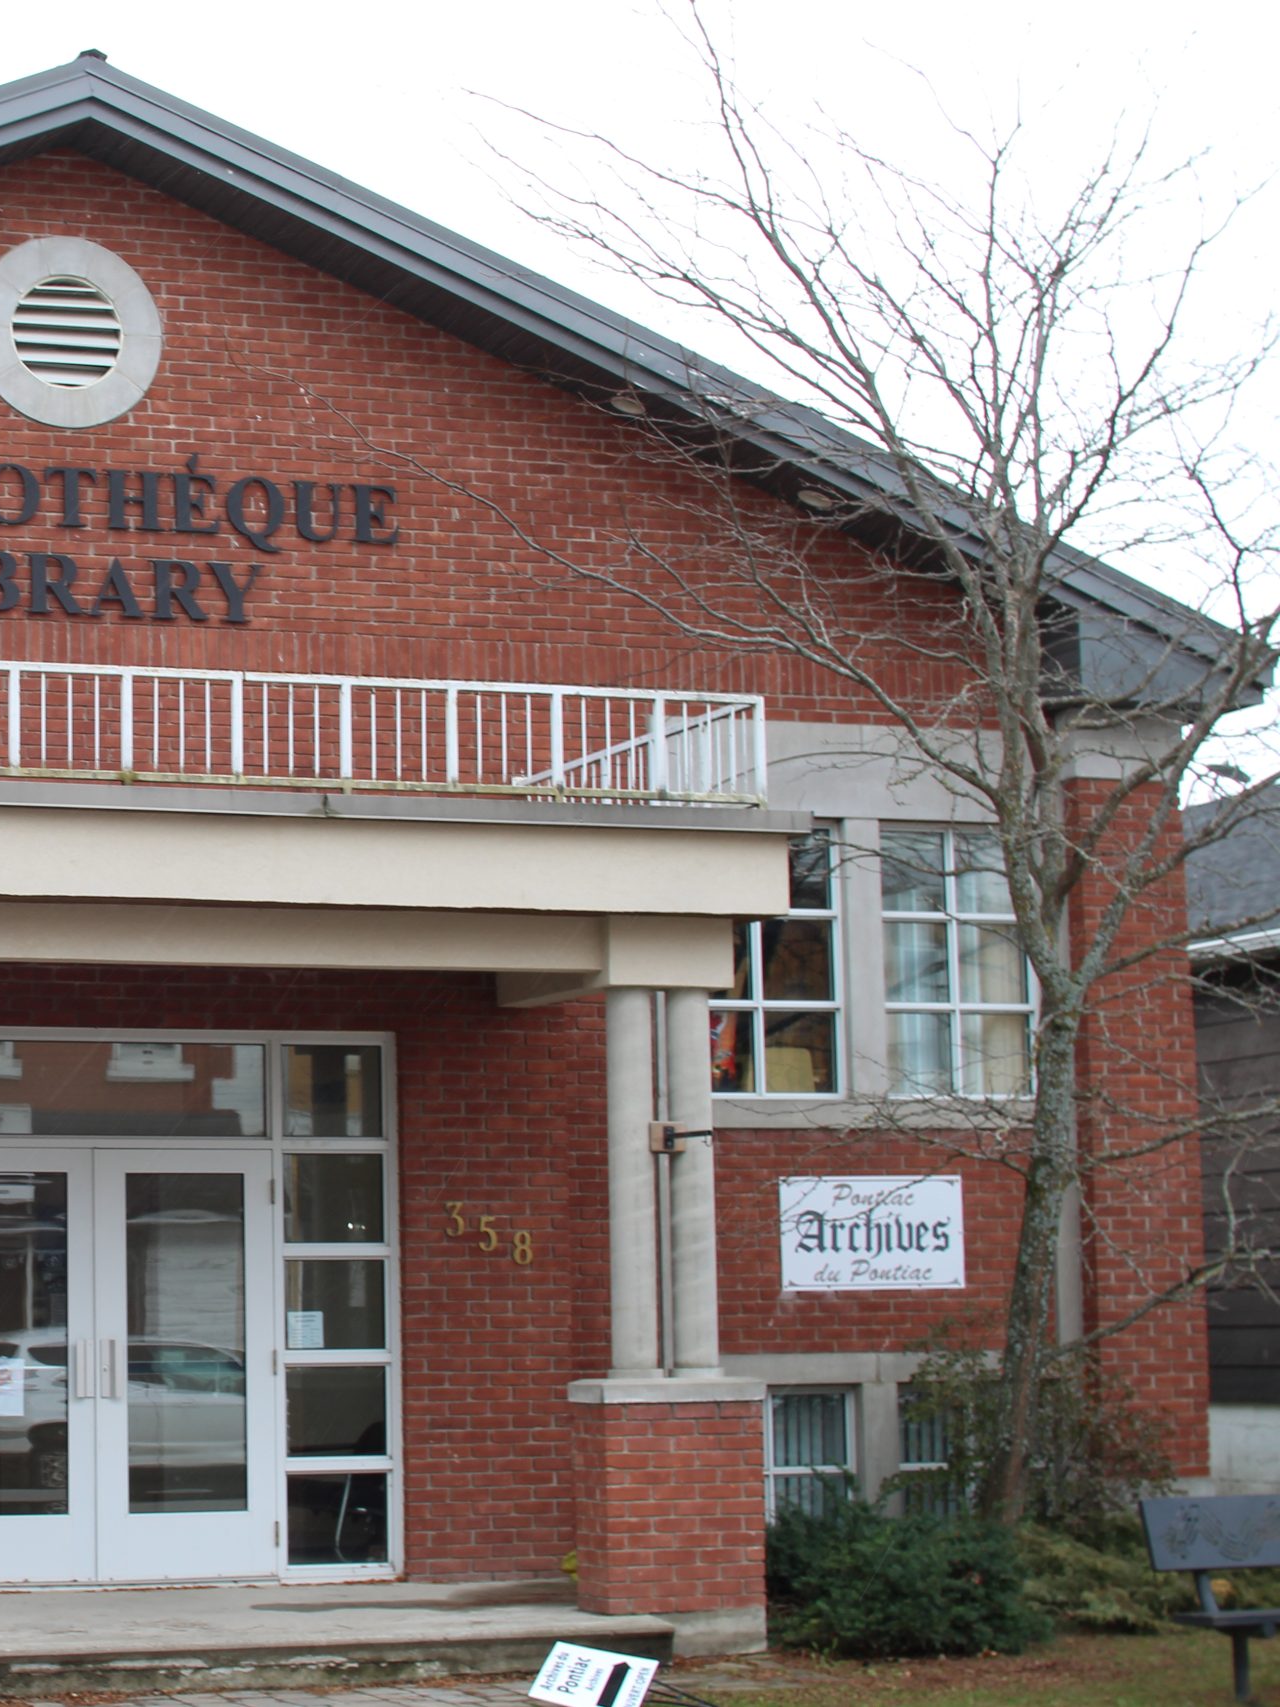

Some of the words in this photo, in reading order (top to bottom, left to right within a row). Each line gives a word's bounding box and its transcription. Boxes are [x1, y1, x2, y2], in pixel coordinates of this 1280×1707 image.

[832, 1183, 915, 1207] Pontiac
[445, 1201, 533, 1265] 358
[795, 1210, 952, 1259] Archives
[814, 1264, 842, 1282] du
[850, 1259, 933, 1282] Pontiac
[540, 1660, 565, 1690] Archives
[557, 1656, 591, 1694] Pontiac
